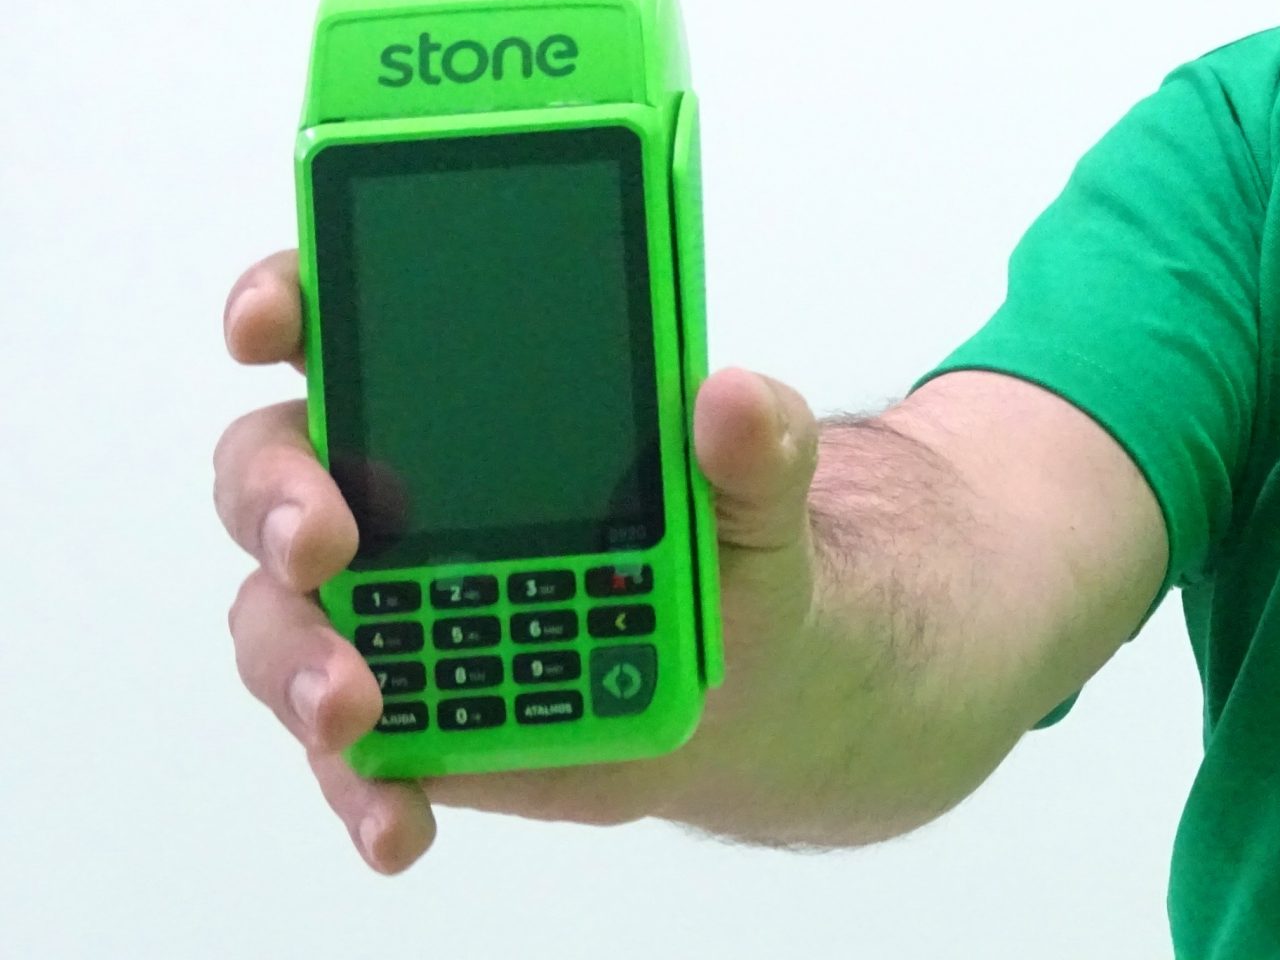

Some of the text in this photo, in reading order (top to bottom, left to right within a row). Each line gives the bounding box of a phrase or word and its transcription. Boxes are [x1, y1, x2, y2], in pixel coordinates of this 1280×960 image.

[377, 32, 579, 88] stone
[450, 585, 462, 602] 2
[525, 579, 537, 597] 3
[372, 591, 381, 608] 1
[451, 626, 463, 644] 5
[529, 620, 541, 637] 6
[455, 666, 466, 684] 8
[531, 660, 543, 677] 9
